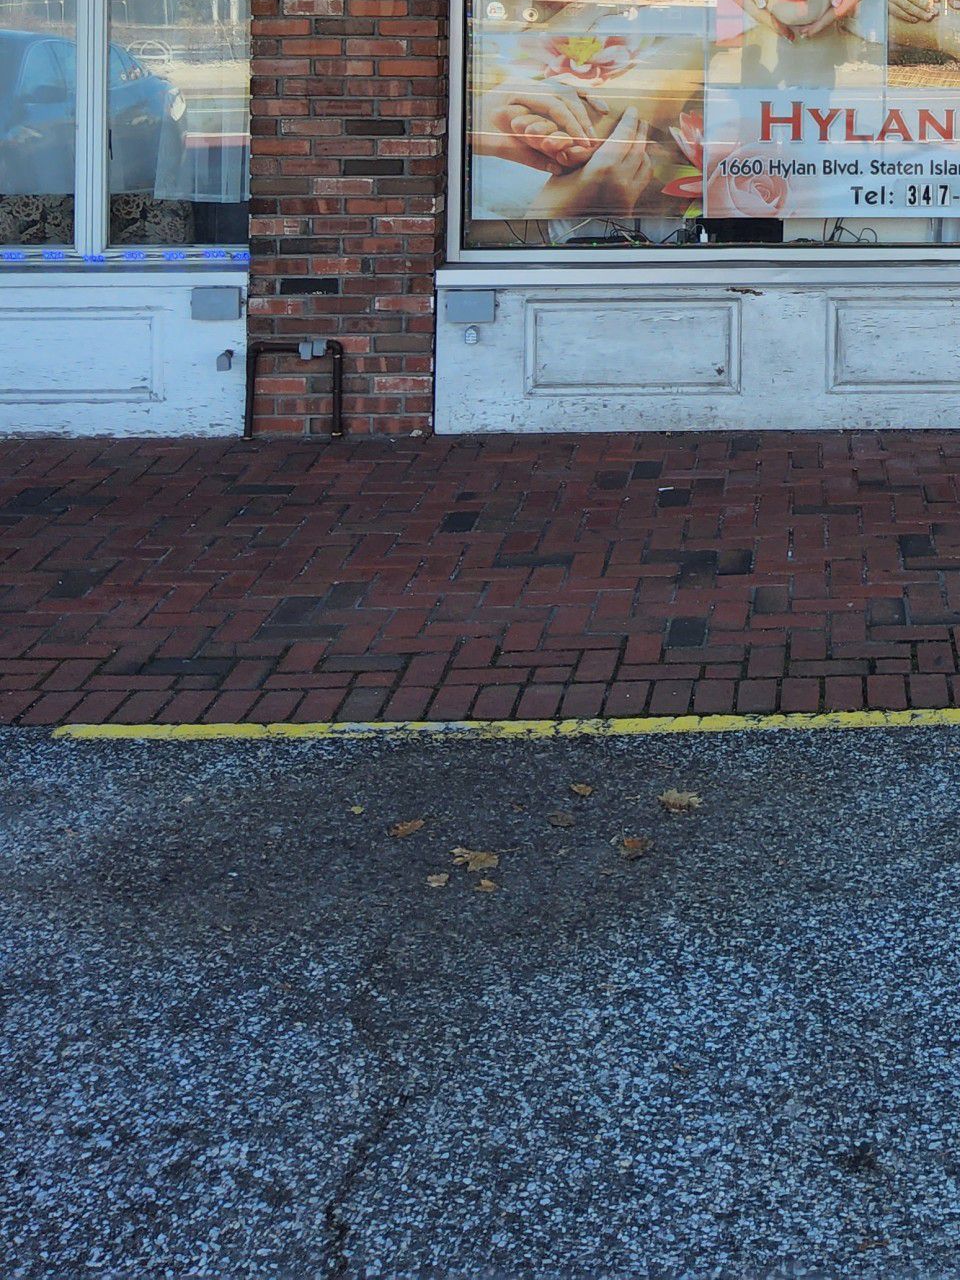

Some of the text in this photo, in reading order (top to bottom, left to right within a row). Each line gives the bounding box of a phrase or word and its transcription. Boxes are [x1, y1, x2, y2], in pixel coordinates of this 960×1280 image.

[759, 101, 956, 143] HYLAN
[719, 159, 763, 176] 1660
[769, 159, 817, 179] Hylan
[822, 159, 864, 176] Blvd.
[870, 159, 924, 176] Staten
[850, 185, 894, 206] Tel:
